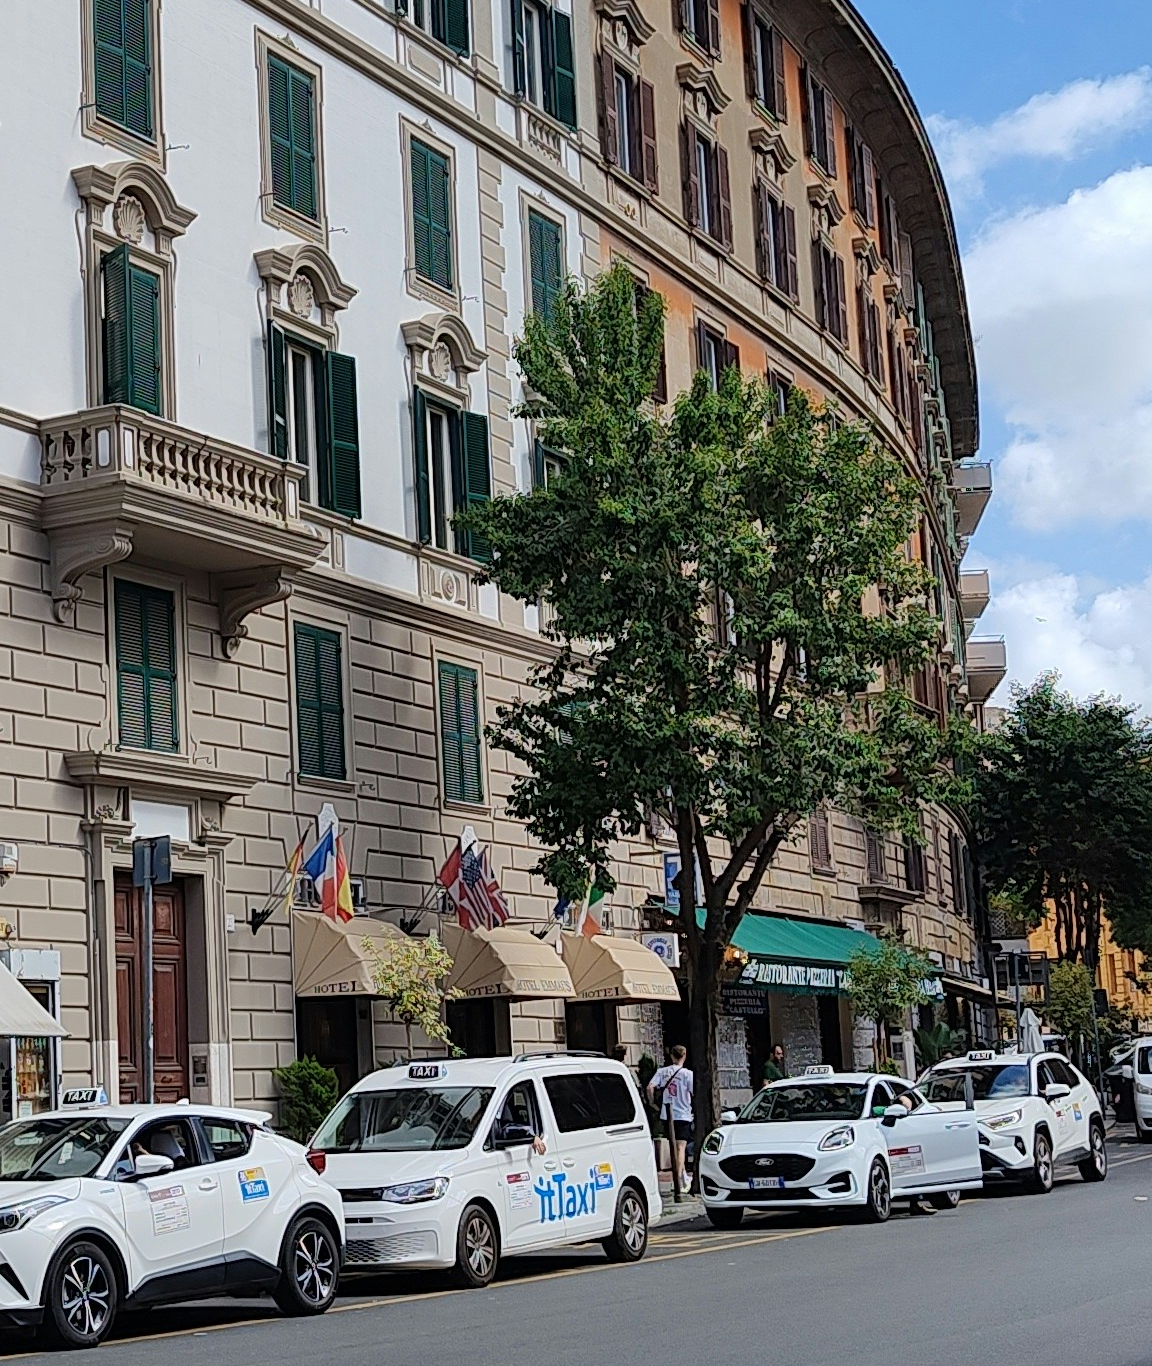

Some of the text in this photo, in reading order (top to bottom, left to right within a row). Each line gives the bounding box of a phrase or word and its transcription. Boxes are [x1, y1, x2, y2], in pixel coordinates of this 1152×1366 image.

[412, 1066, 436, 1077] TAXI
[67, 1090, 92, 1102] TAXI
[533, 1168, 596, 1223] itTaxi
